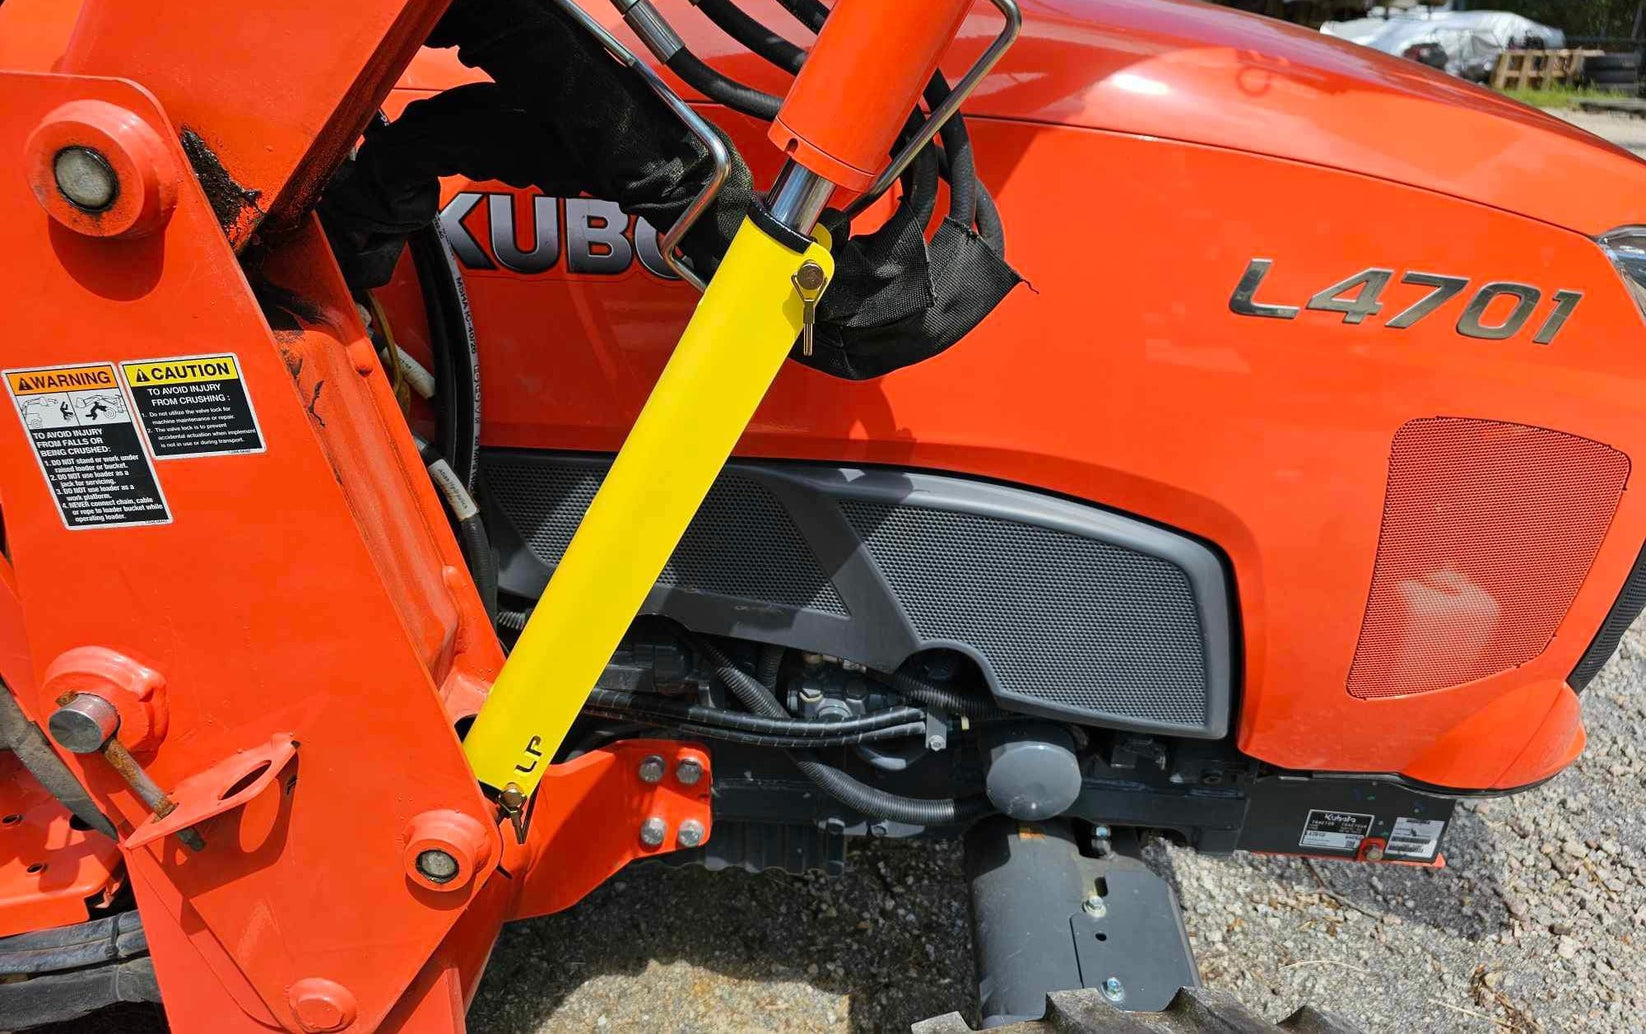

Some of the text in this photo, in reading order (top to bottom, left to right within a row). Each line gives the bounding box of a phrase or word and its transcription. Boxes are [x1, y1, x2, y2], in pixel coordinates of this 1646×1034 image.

[1229, 258, 1584, 345] L4701
[151, 362, 230, 380] CAUTION
[29, 371, 111, 389] WARNING
[147, 388, 160, 396] TO
[162, 386, 188, 394] AVOID
[180, 394, 225, 404] CRUSHING
[47, 431, 72, 439] AVOID
[228, 428, 256, 436] implement
[40, 446, 111, 457] BEING CRUSHED:
[1324, 813, 1356, 823] Kubota
